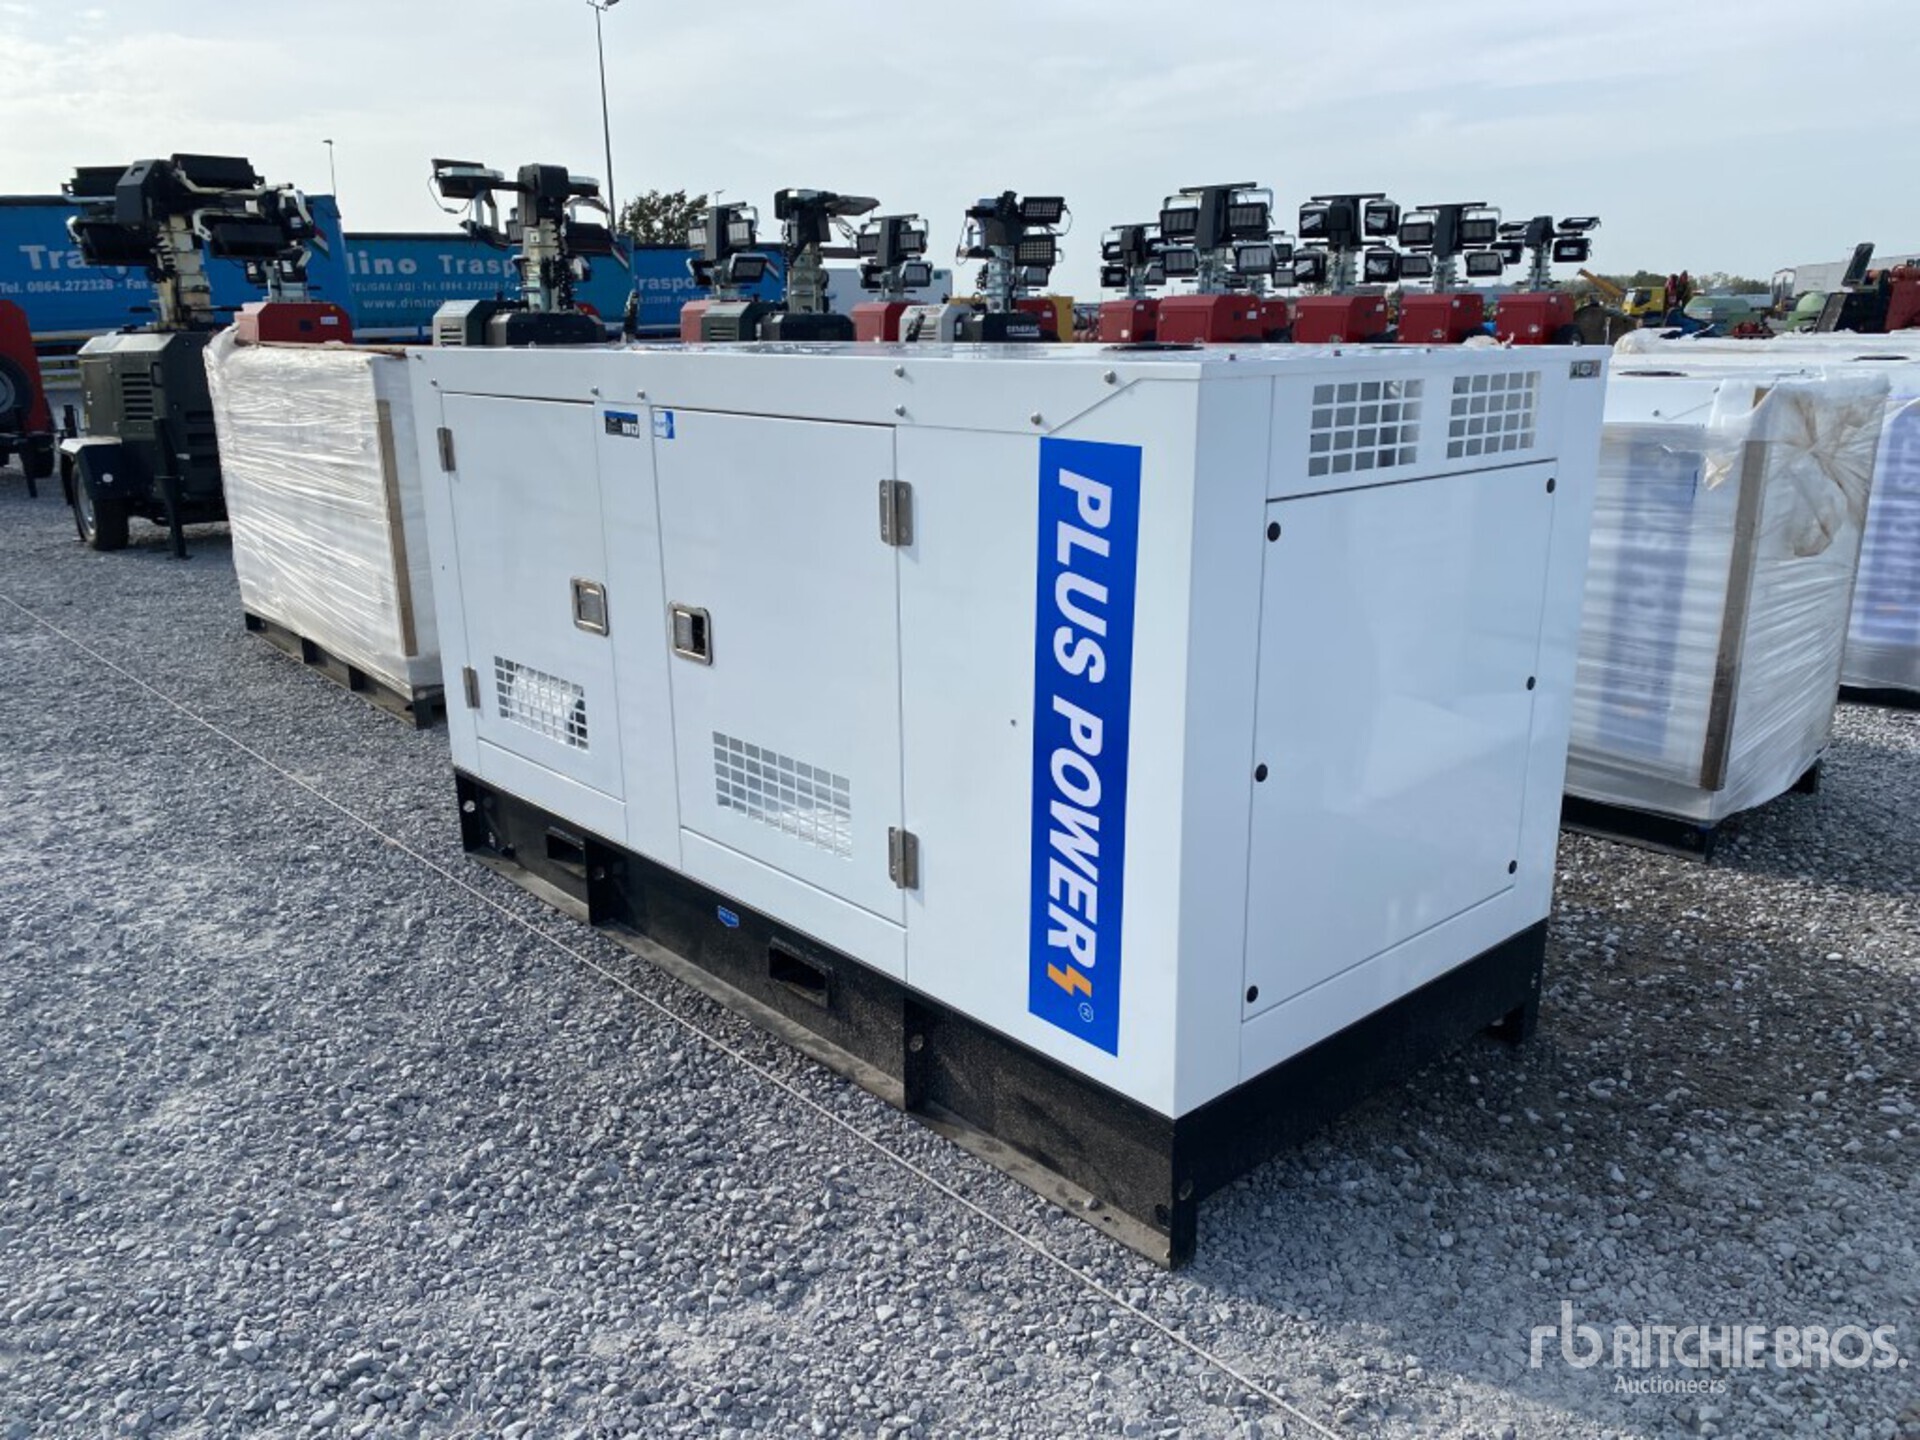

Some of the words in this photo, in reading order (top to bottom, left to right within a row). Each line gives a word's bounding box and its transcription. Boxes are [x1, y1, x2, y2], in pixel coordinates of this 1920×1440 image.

[438, 254, 516, 278] Trasp
[1053, 467, 1113, 684] PLUS
[1048, 694, 1104, 968] POWER
